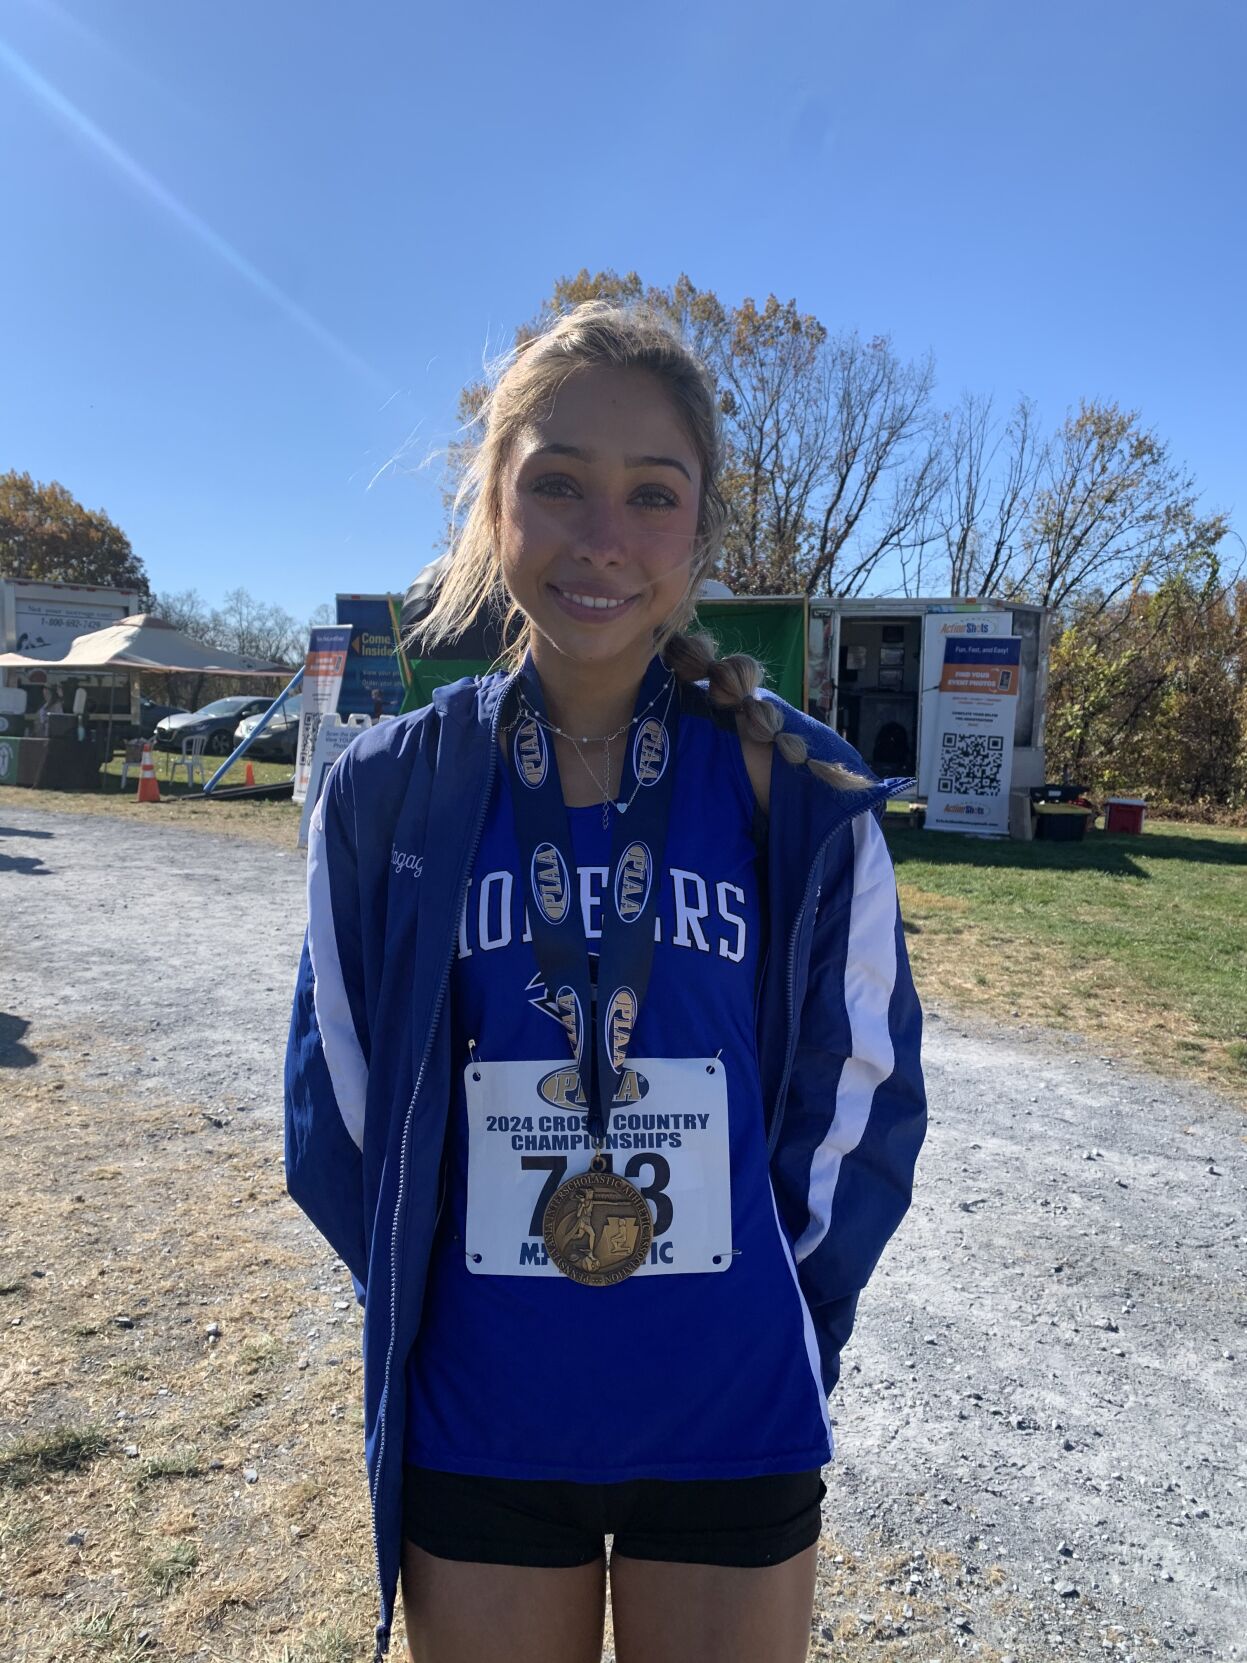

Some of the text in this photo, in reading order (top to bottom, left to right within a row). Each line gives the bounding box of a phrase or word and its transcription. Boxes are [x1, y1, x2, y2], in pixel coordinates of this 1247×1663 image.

[362, 632, 391, 644] Come
[362, 645, 393, 656] Inside
[536, 848, 564, 911] PIAA
[619, 852, 647, 916] PIAA
[486, 1113, 710, 1132] 2024 CROS COUNTRY
[520, 1152, 674, 1237] 73
[546, 1175, 624, 1220] INTERSCHOLASTIC
[623, 1183, 651, 1231] ATHLETIC
